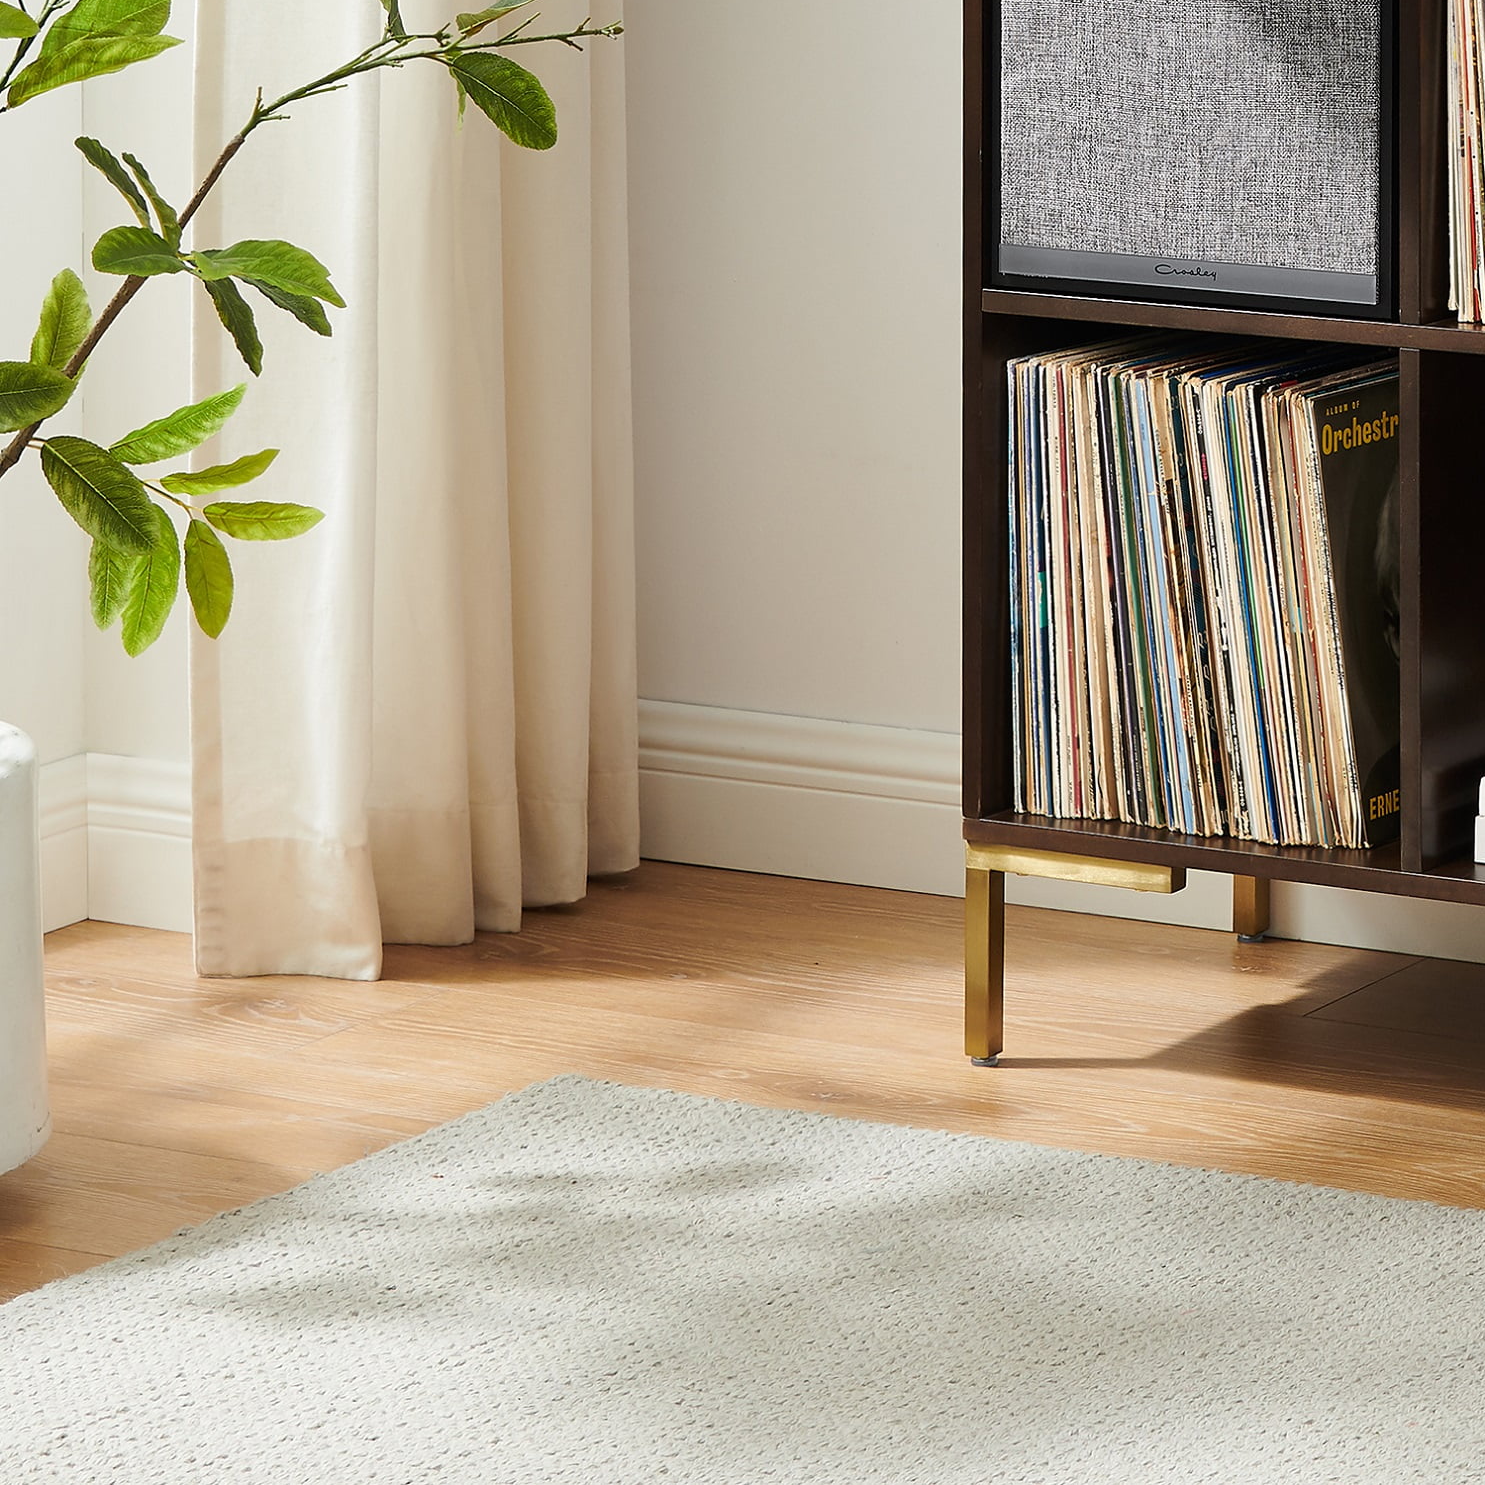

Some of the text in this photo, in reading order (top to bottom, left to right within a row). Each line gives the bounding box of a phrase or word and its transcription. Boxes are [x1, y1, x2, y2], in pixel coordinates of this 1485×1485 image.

[1154, 264, 1218, 281] Crosley
[1326, 400, 1360, 416] ALBUM OF
[1321, 410, 1399, 456] Orchestr
[1369, 788, 1400, 821] ERNE
